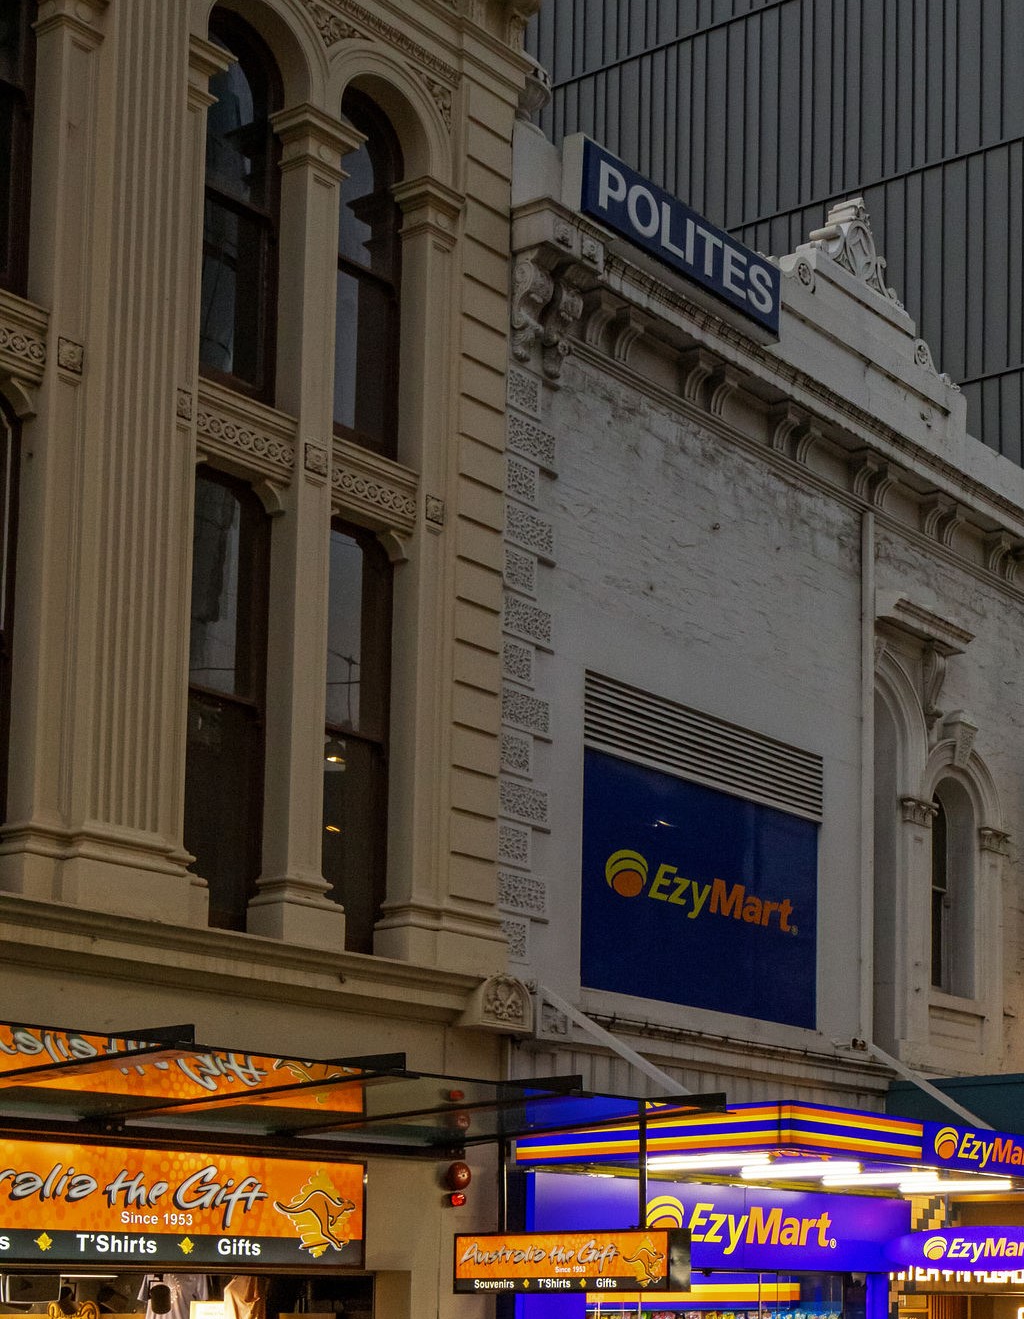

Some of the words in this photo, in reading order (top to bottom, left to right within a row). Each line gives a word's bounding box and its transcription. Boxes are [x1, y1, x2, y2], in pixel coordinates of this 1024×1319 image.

[599, 160, 773, 314] POLITES
[104, 1169, 168, 1207] the
[174, 1165, 268, 1229] Gift
[121, 1211, 159, 1226] Since
[163, 1212, 193, 1226] 1953
[76, 1234, 157, 1254] T'Shirts
[217, 1238, 261, 1256] Gifts
[460, 1242, 545, 1266] Australia
[549, 1245, 575, 1264] the
[577, 1239, 619, 1273] Gift
[474, 1278, 515, 1289] Souvenirs
[538, 1278, 571, 1288] T'Shirts
[596, 1277, 617, 1288] Gifts
